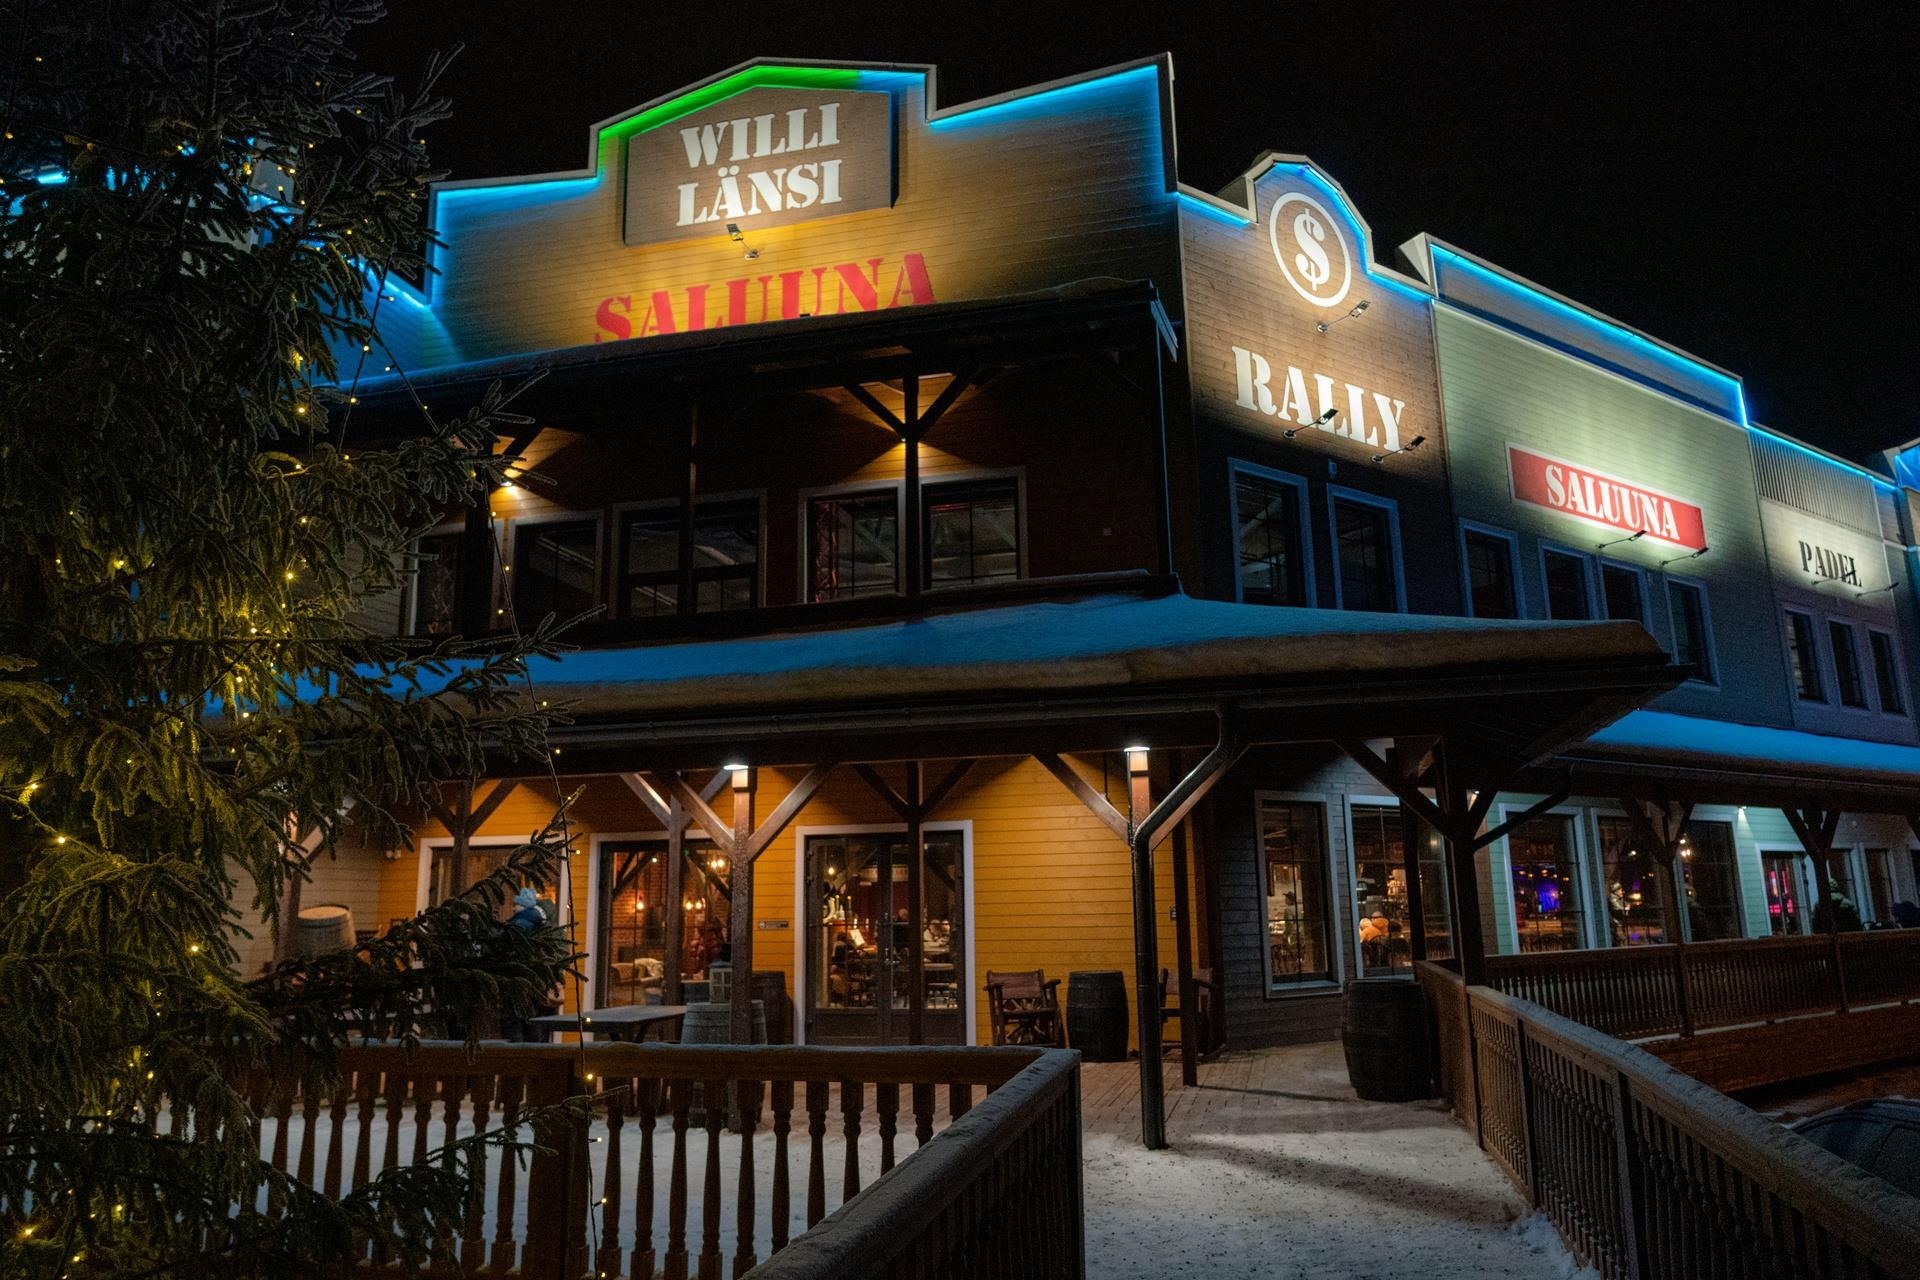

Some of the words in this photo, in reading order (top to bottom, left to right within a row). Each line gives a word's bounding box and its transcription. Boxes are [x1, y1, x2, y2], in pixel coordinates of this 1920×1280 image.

[680, 102, 841, 168] WILLI
[675, 159, 843, 227] LÄNSI
[594, 252, 935, 343] SALUUNA
[1231, 345, 1405, 453] RALLY
[1545, 464, 1681, 541] SALUUNA
[1798, 540, 1863, 588] PADEL
